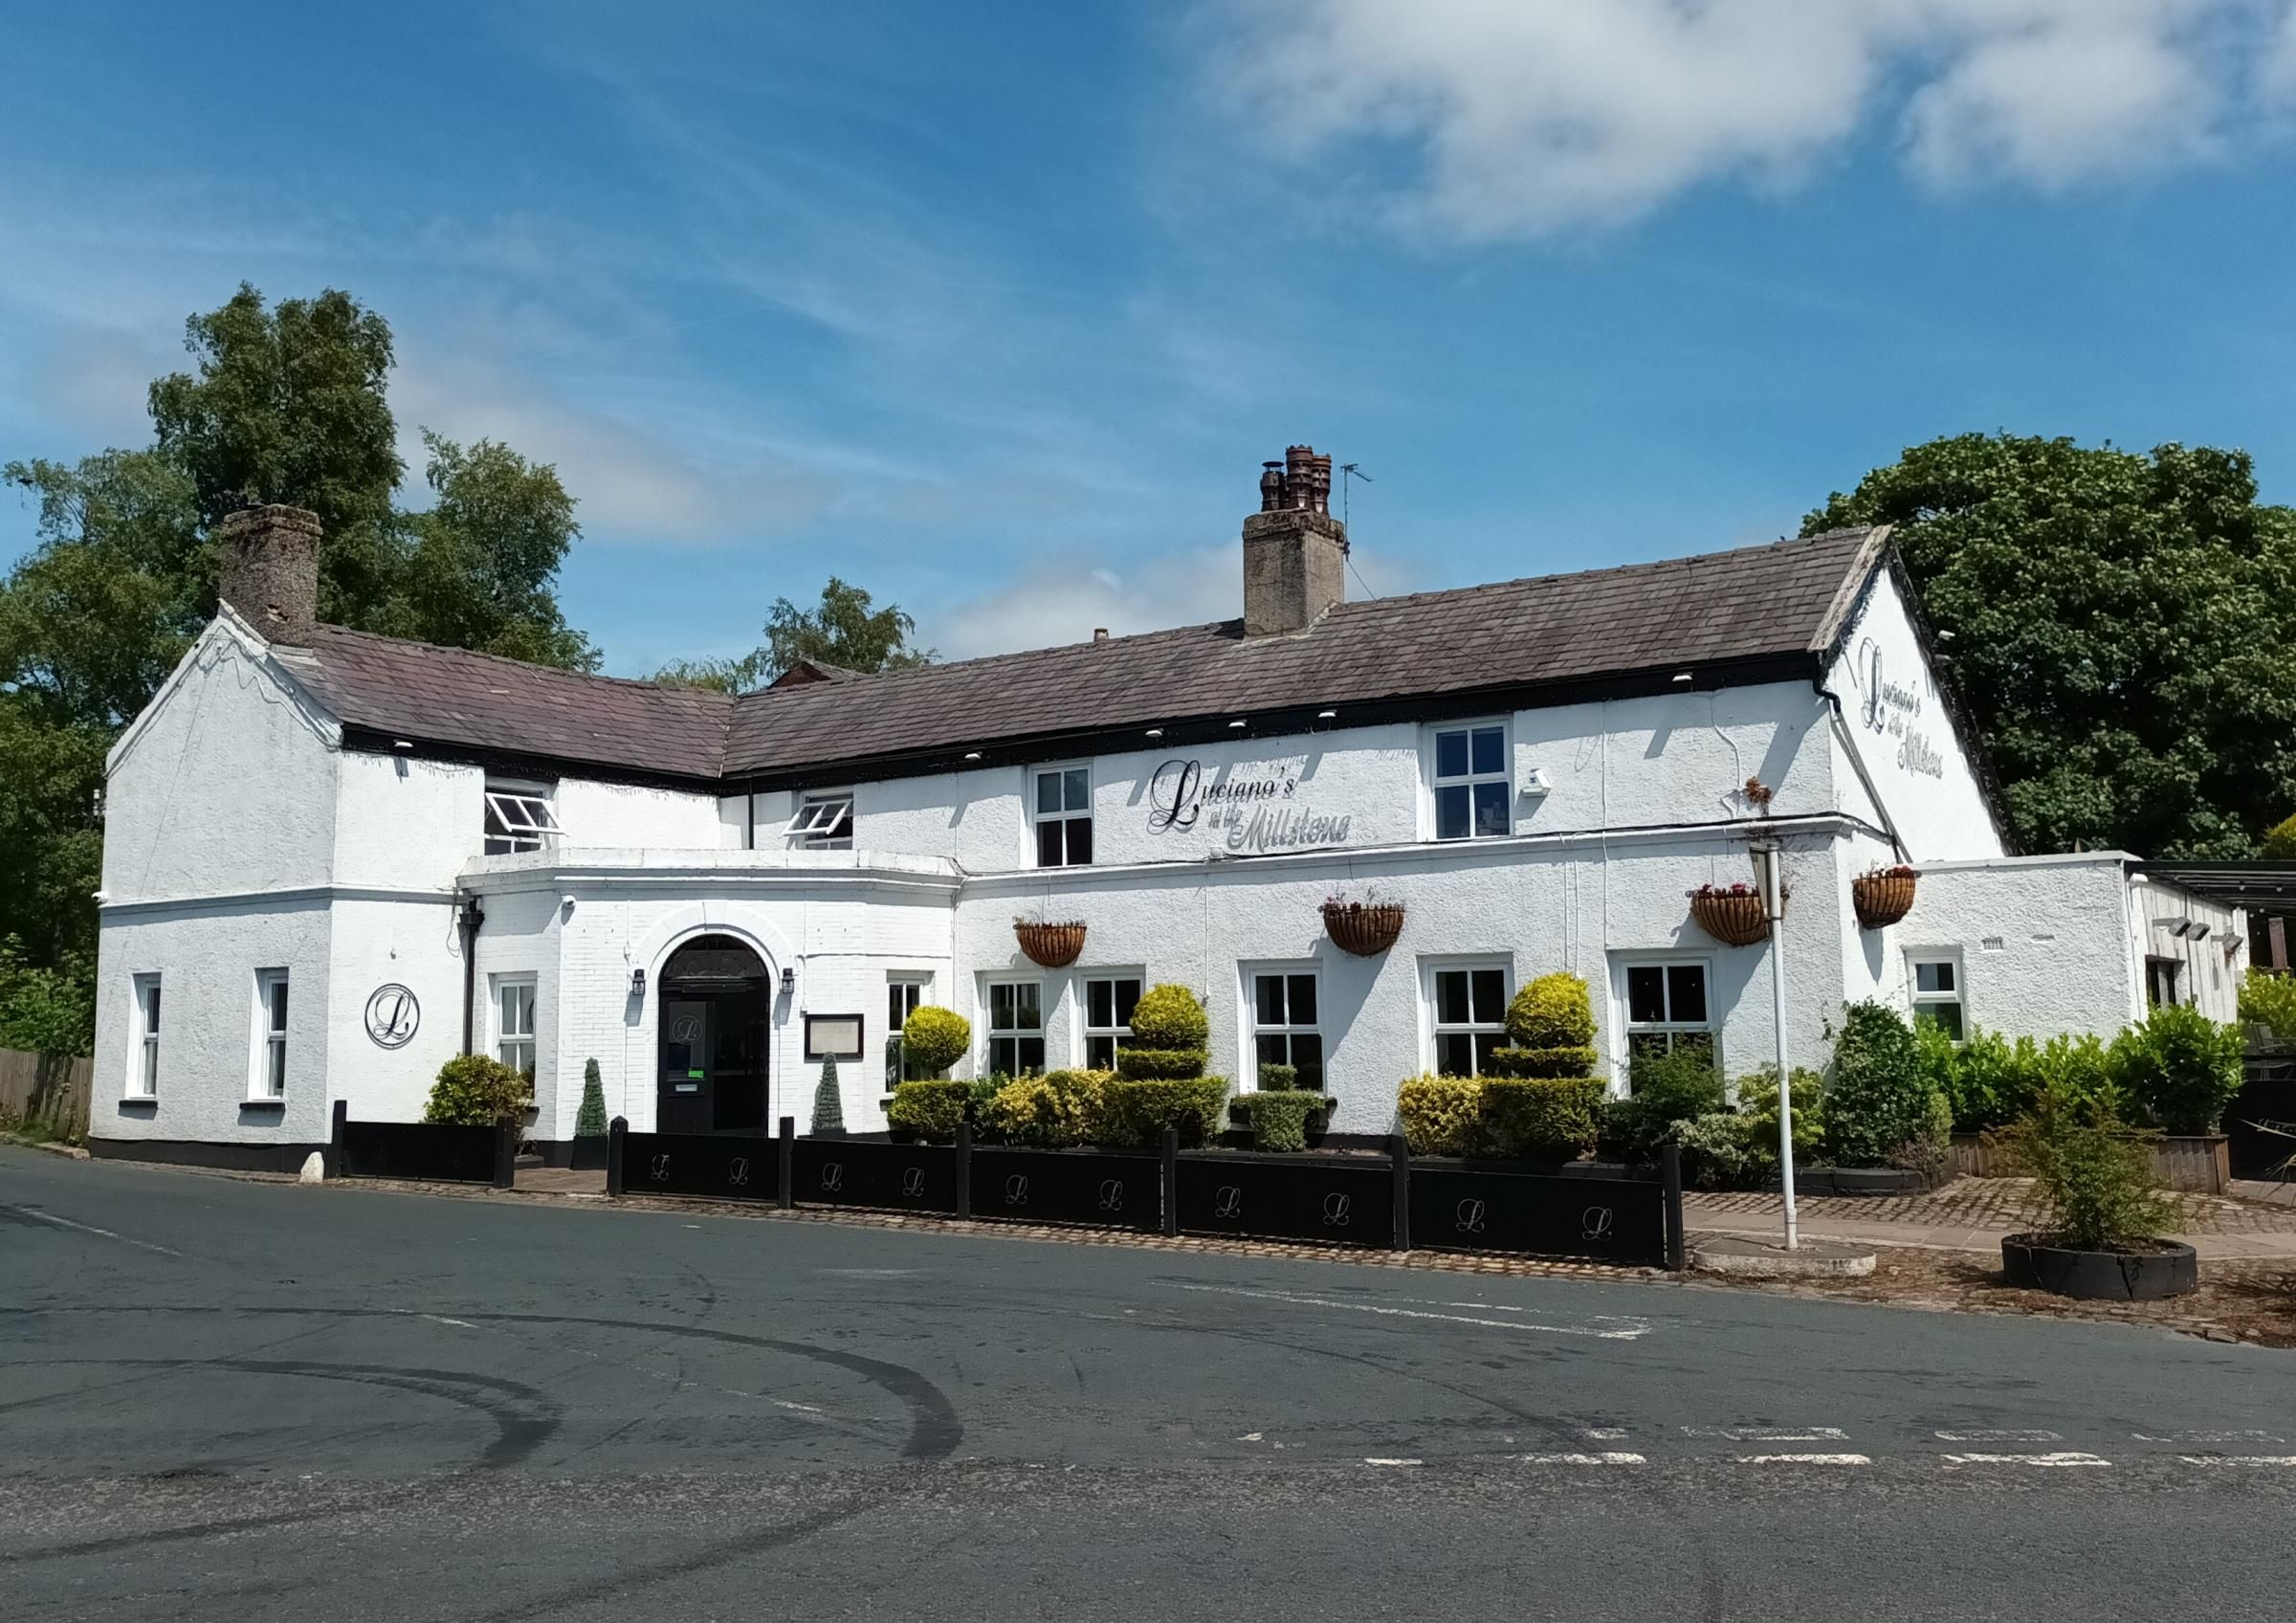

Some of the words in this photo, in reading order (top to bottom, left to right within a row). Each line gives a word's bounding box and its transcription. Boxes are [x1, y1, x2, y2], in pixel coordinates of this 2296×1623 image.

[1149, 760, 1294, 827] Luciano's
[1227, 804, 1351, 853] Millstone
[373, 990, 410, 1039] L
